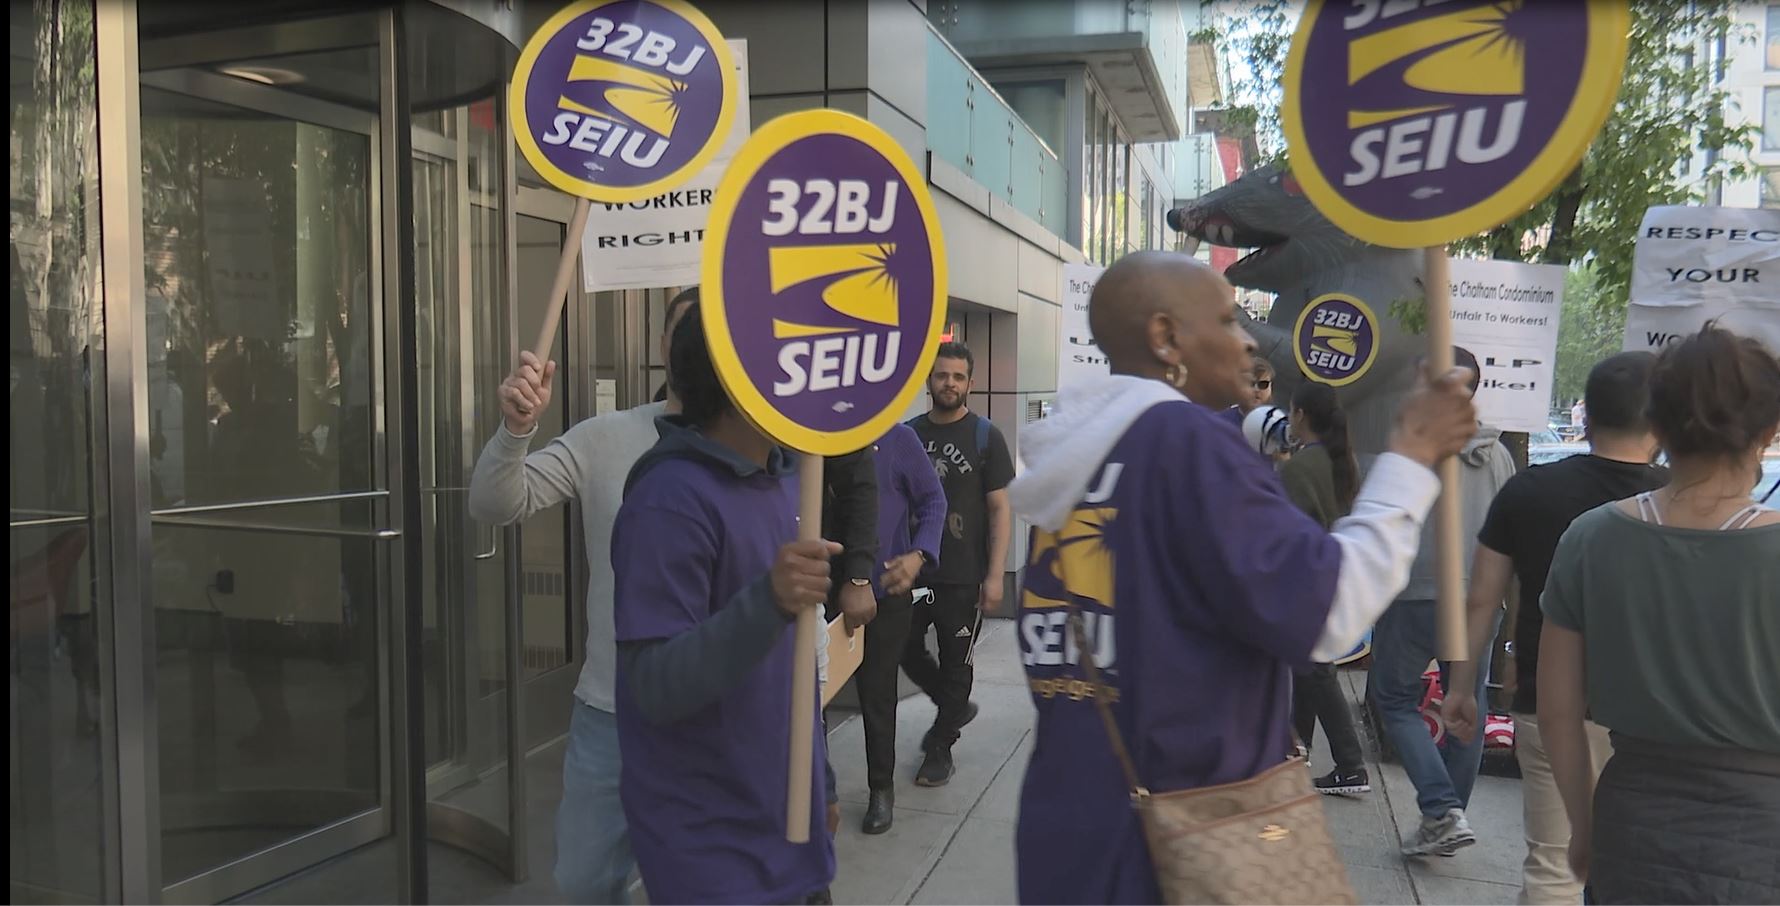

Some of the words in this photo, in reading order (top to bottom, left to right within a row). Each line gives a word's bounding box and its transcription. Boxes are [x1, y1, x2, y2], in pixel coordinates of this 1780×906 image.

[576, 17, 706, 75] 32BJ
[542, 113, 670, 168] SEIU
[1343, 99, 1527, 187] SEIU
[604, 188, 715, 211] WORKER
[761, 178, 899, 236] 32BJ
[1646, 227, 1780, 242] RESPEC
[1070, 279, 1081, 293] The
[1666, 268, 1760, 283] YOUR
[1460, 281, 1497, 299] Chatham
[1499, 283, 1554, 304] Condominium
[1313, 308, 1364, 330] 32BJ
[1449, 310, 1482, 321] Unfair
[1485, 312, 1497, 323] To
[1500, 313, 1548, 327] Workers!
[773, 331, 901, 397] SEIU
[1306, 350, 1356, 371] SEIU
[1481, 379, 1536, 391] ike!
[942, 443, 973, 474] OUT
[1021, 611, 1117, 669] SEIU
